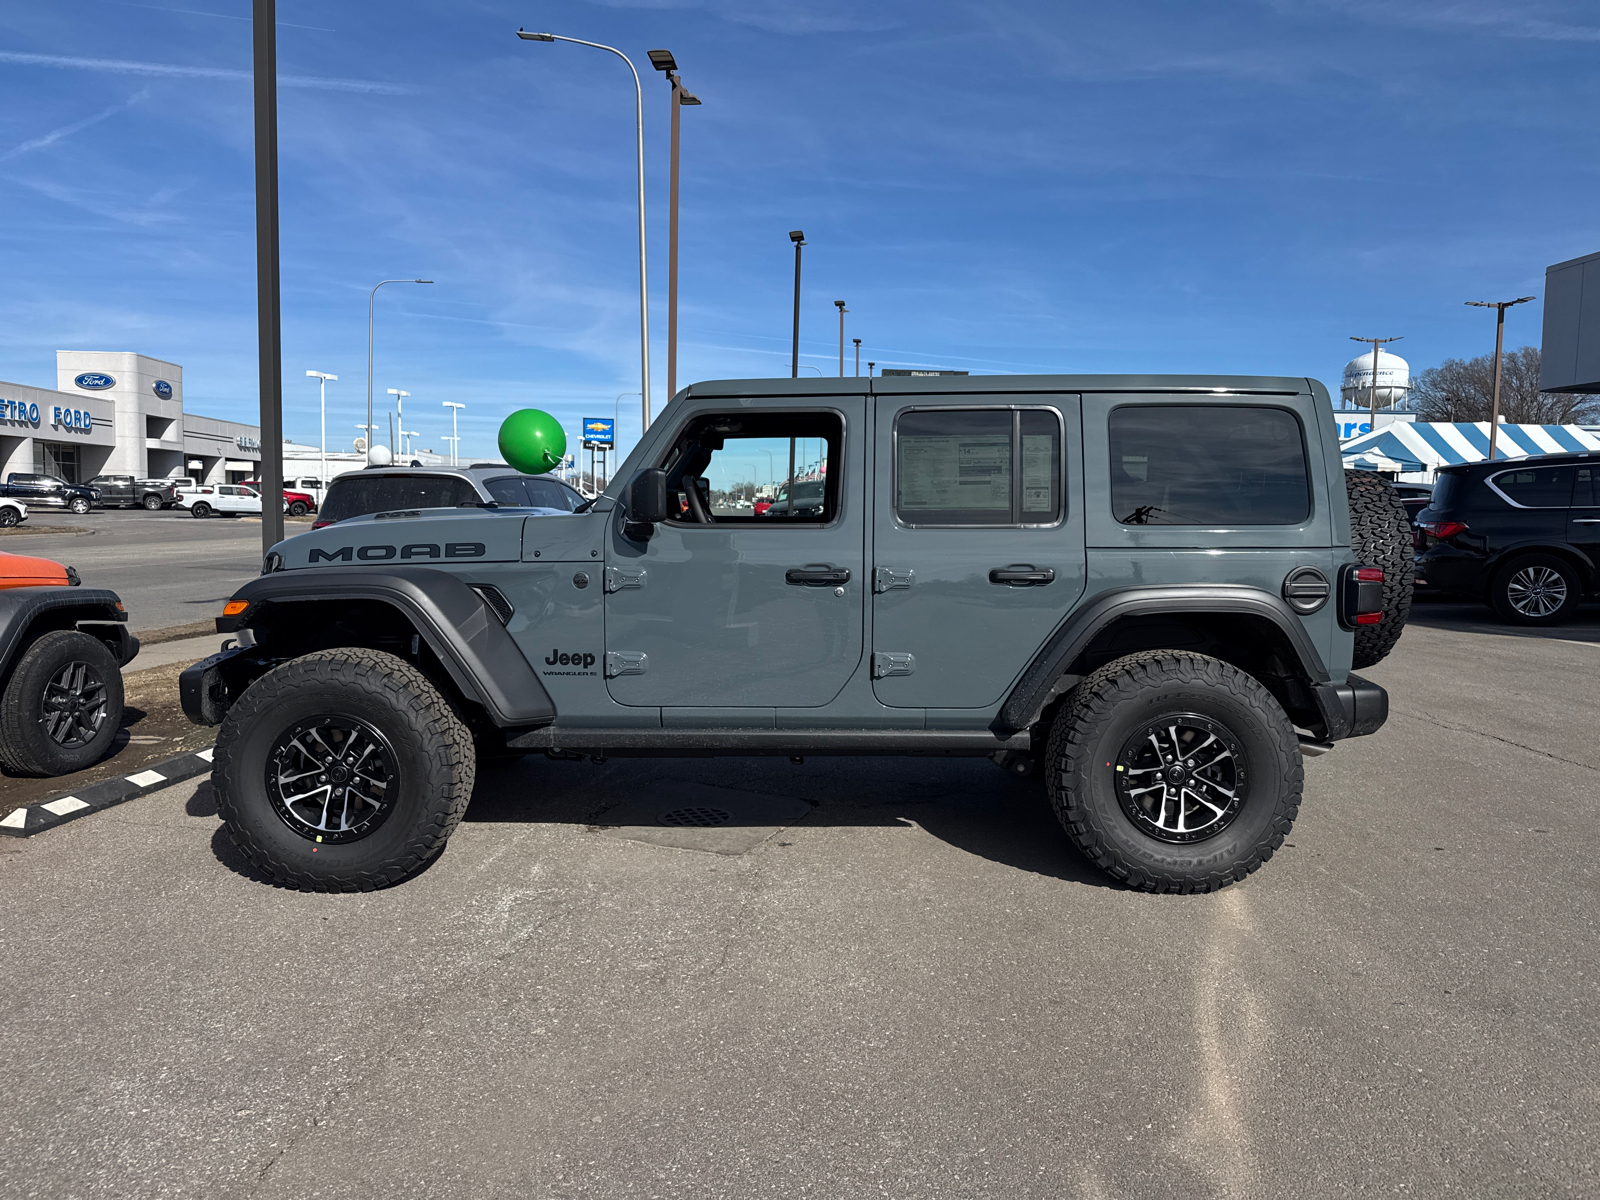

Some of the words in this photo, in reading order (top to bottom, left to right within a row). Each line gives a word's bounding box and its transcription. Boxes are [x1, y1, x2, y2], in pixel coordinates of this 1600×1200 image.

[82, 375, 106, 386] Ford
[159, 383, 170, 393] Ford
[53, 406, 91, 428] FORD
[308, 542, 486, 563] MOAB
[544, 648, 596, 669] Jeep
